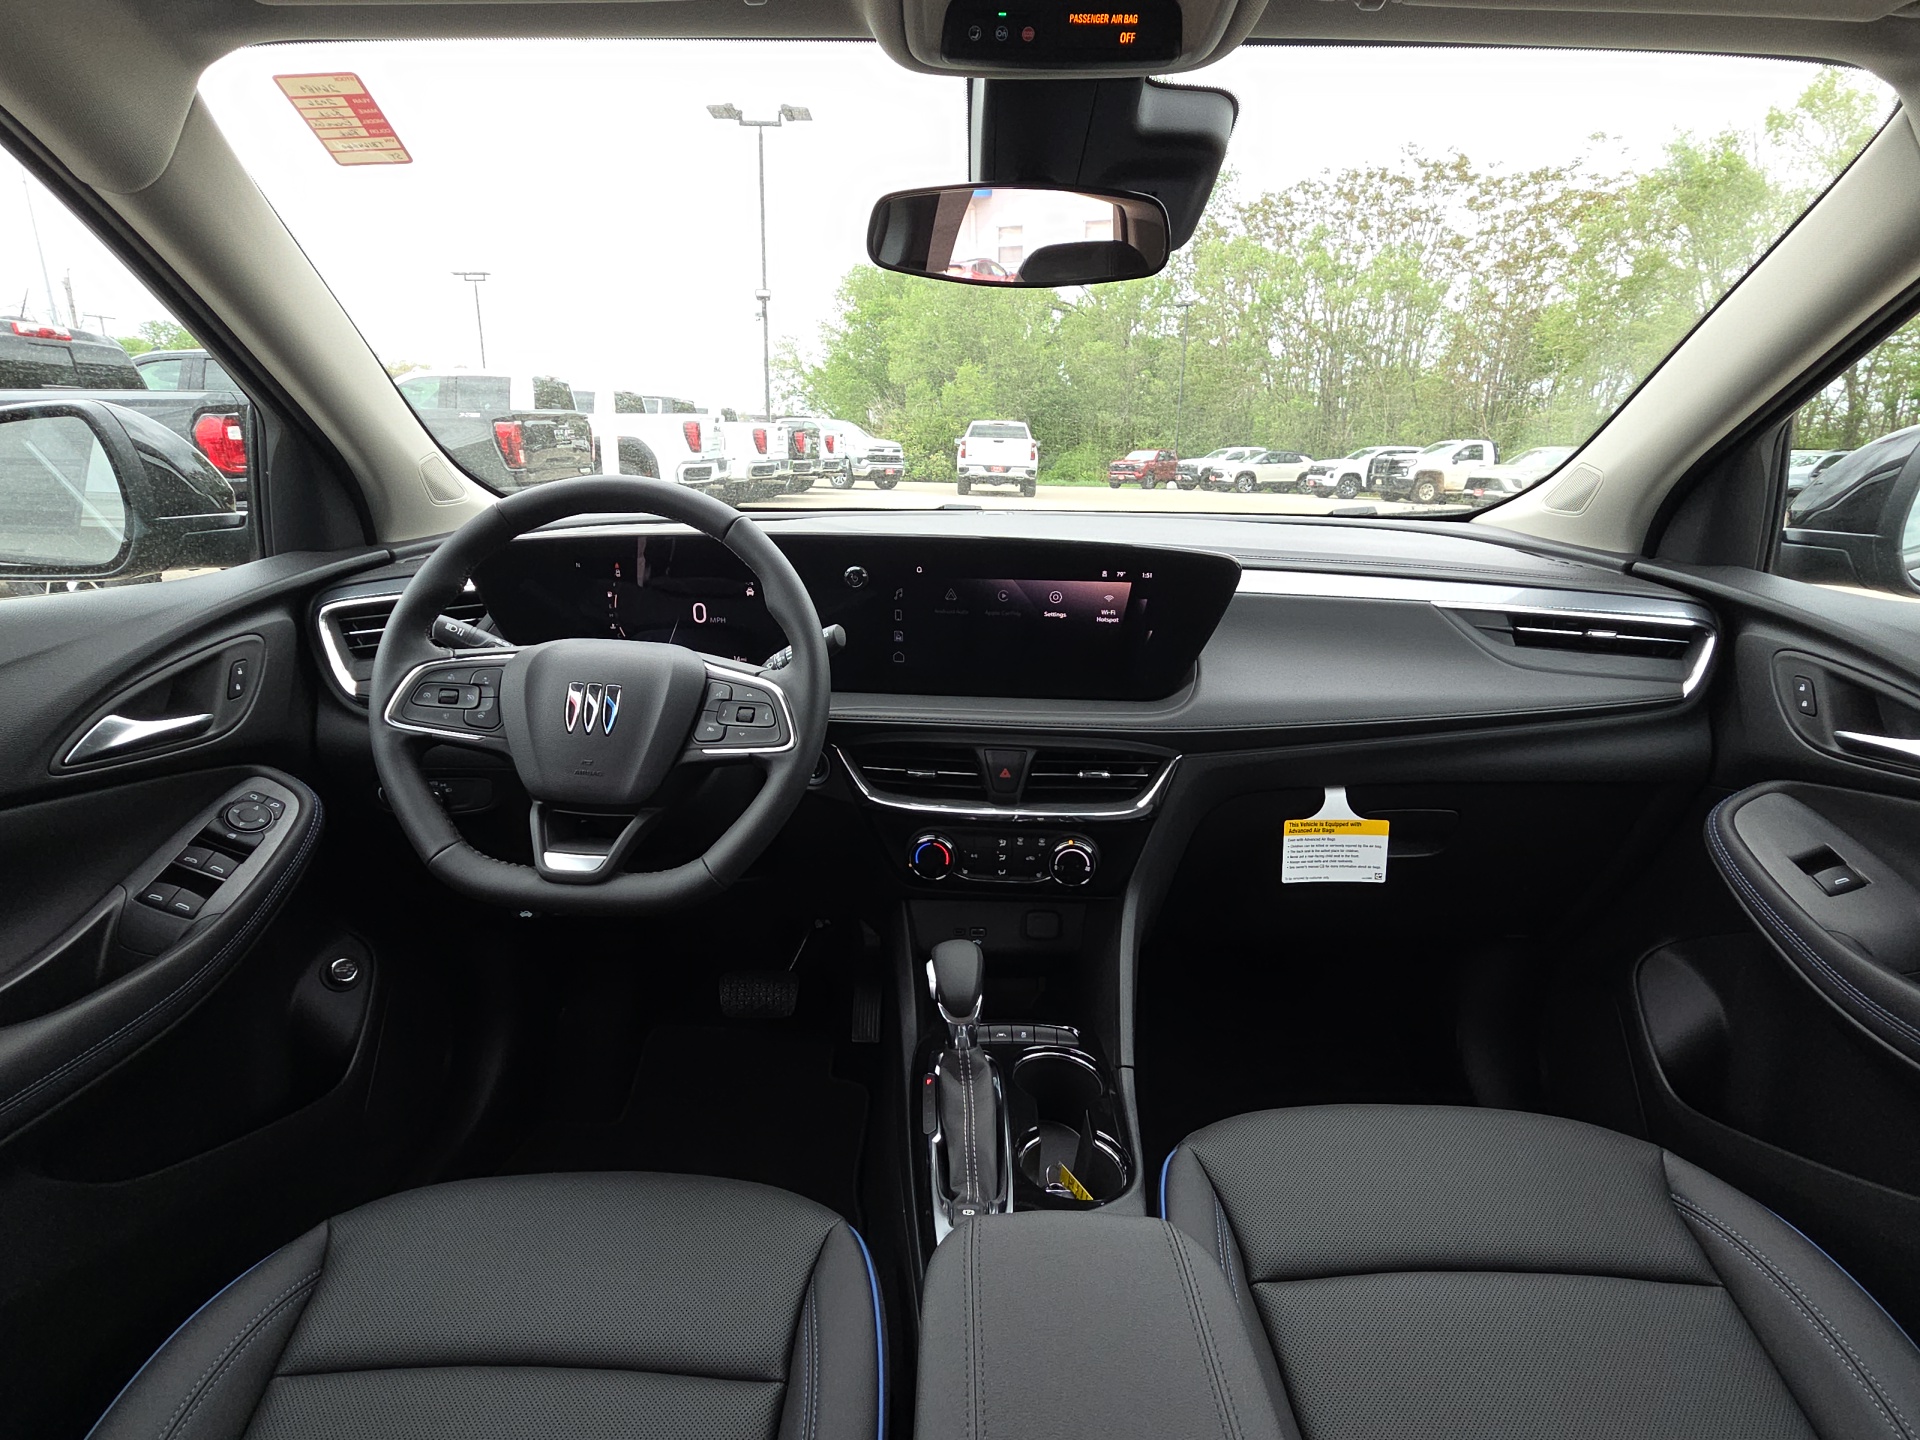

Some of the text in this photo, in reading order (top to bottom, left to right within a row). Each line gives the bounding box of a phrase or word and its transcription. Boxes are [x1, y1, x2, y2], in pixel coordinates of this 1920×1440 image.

[1069, 13, 1138, 24] PASSENGER AIR BAG
[1120, 32, 1136, 44] OFF
[692, 602, 707, 624] 0
[1044, 610, 1068, 618] Settings
